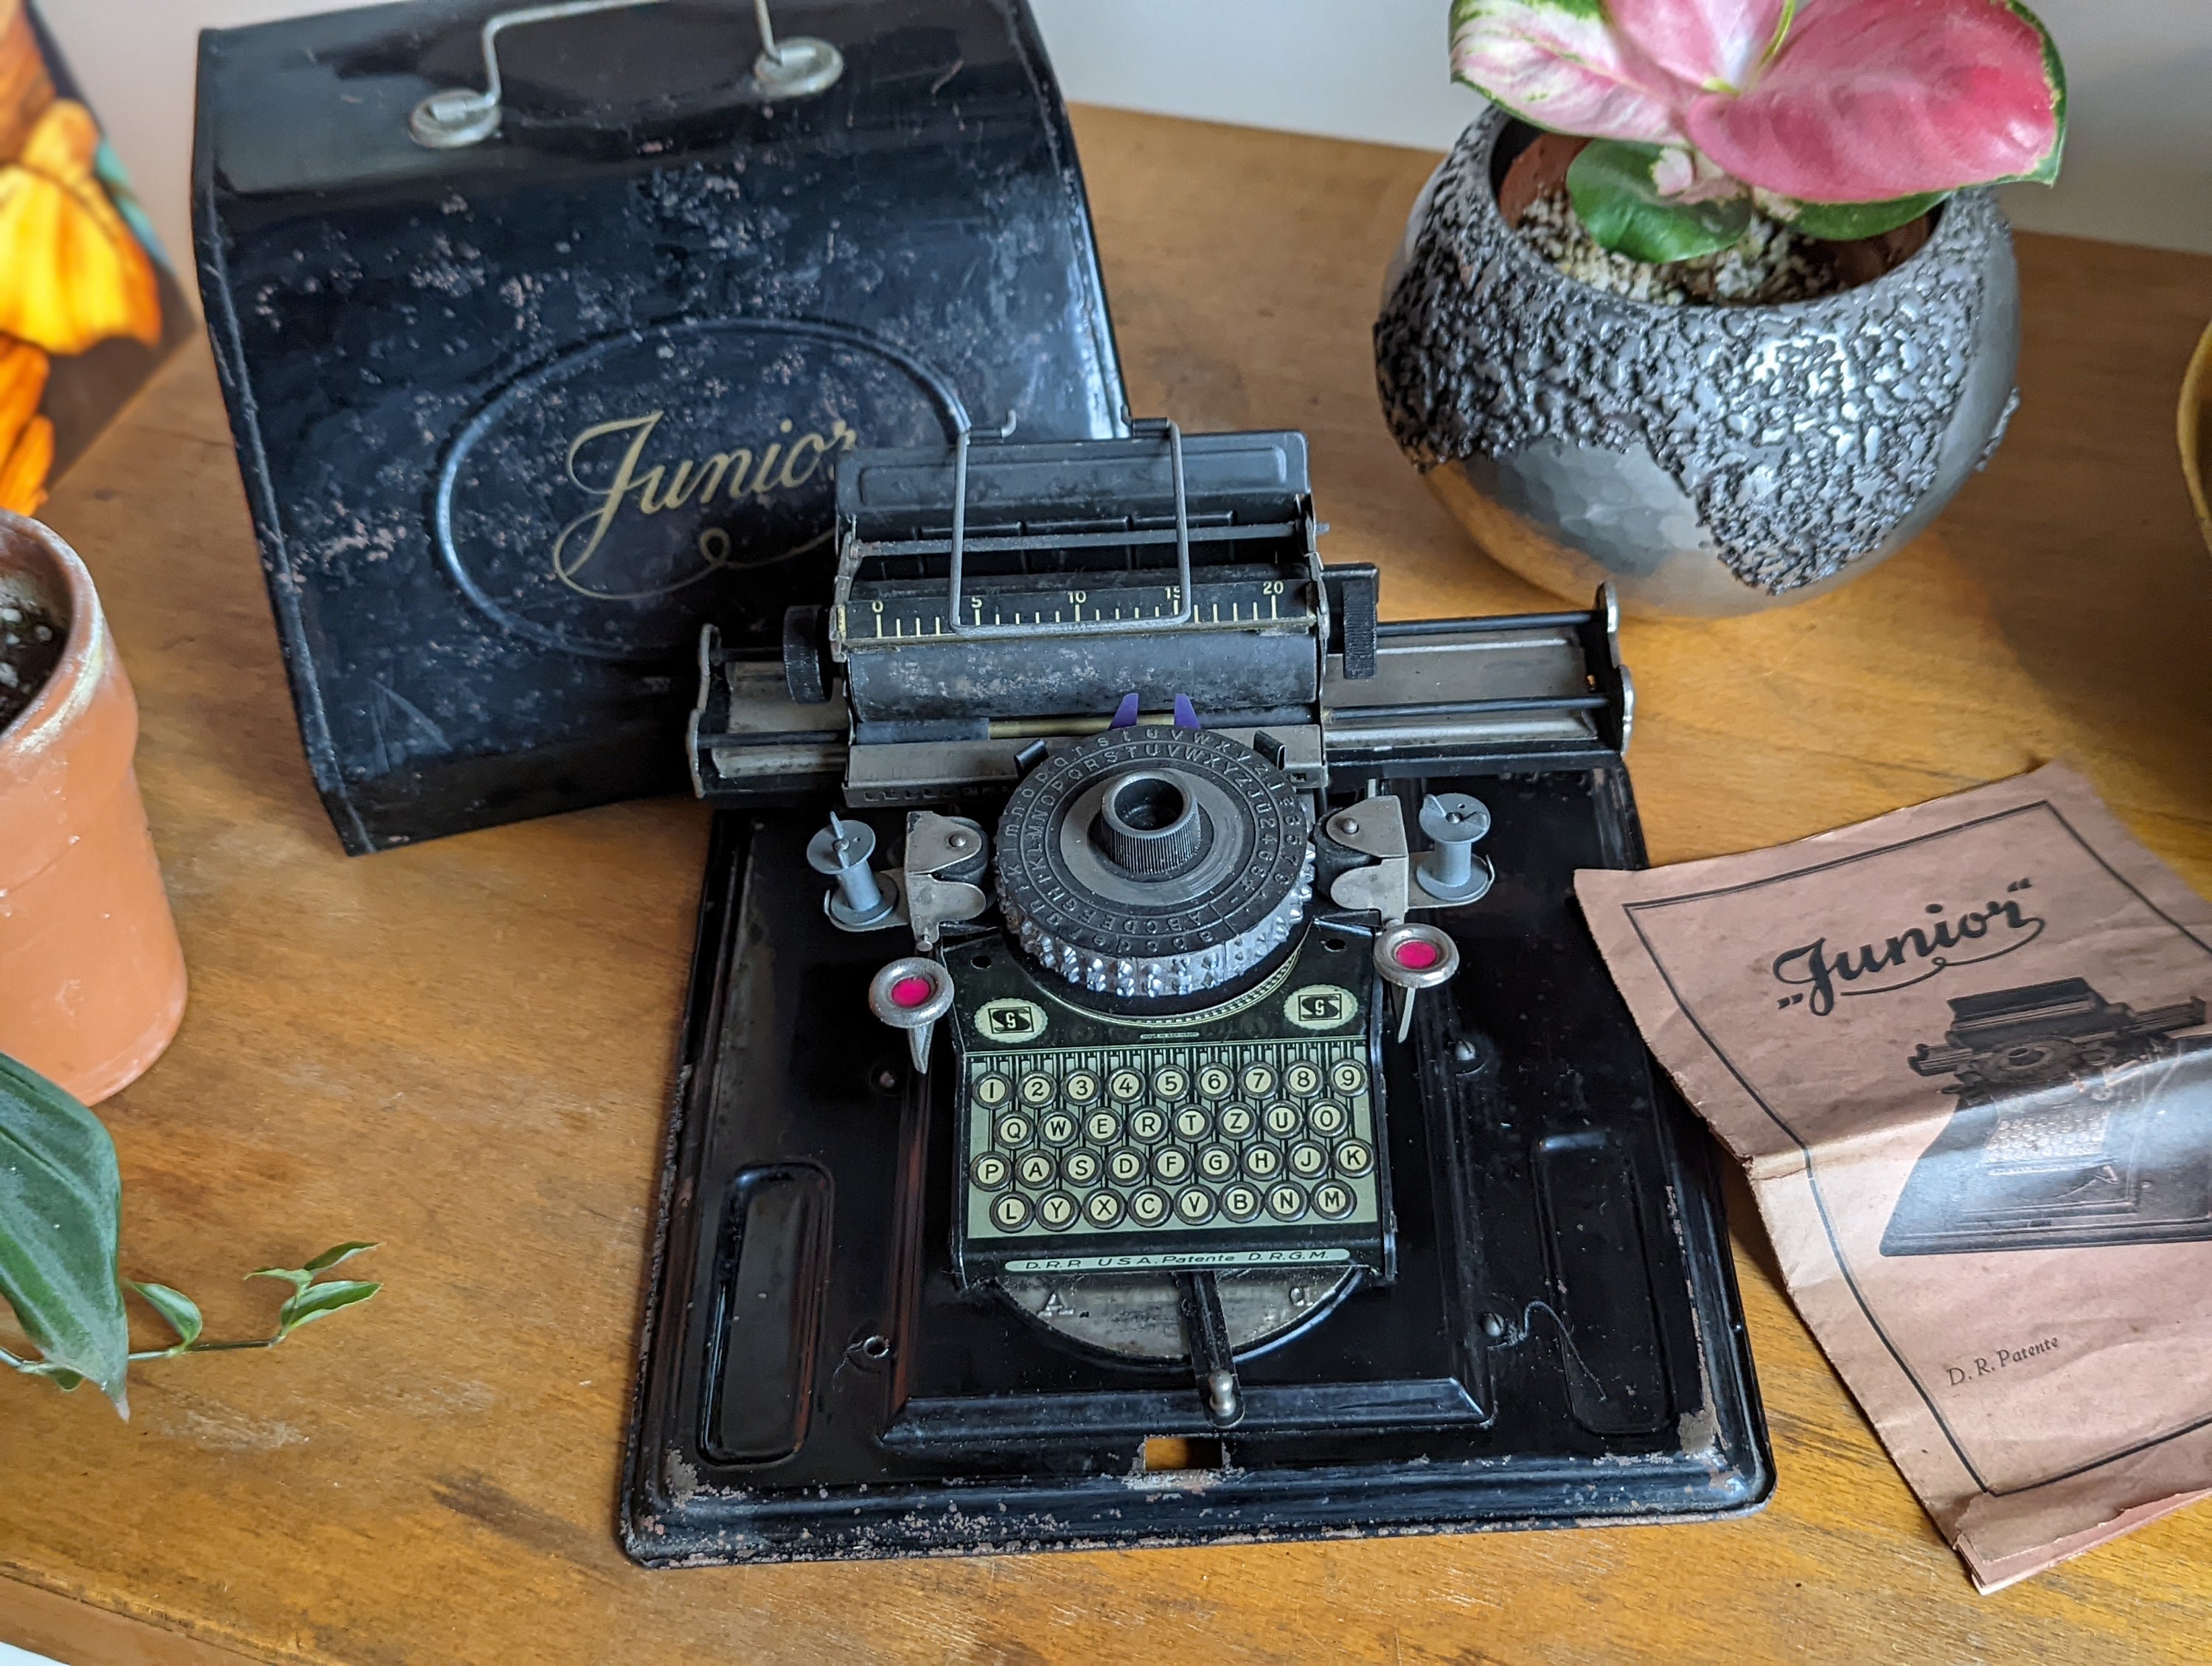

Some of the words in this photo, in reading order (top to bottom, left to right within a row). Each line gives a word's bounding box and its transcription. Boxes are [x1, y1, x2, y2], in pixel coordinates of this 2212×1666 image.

[872, 600, 884, 613] 0
[970, 596, 982, 608] 5
[1068, 591, 1087, 604] 10
[1164, 586, 1180, 599] 15
[1263, 580, 1284, 594] 20
[1031, 1081, 1044, 1097] 2
[1076, 1079, 1088, 1097] 3
[1119, 1077, 1133, 1094] 4
[1165, 1075, 1178, 1092] 5
[1208, 1073, 1221, 1090] 6
[1253, 1072, 1265, 1089] 7
[1297, 1070, 1311, 1088] 8
[1340, 1069, 1355, 1086] 9
[1006, 1122, 1021, 1139] Q
[1050, 1120, 1067, 1137] W
[1097, 1118, 1108, 1134] E
[1141, 1116, 1155, 1133] R
[1185, 1114, 1197, 1131] T
[1230, 1112, 1243, 1129] Z
[1276, 1111, 1288, 1129] U
[1319, 1110, 1334, 1128] O
[985, 1163, 999, 1180] P
[1028, 1162, 1043, 1178] A
[1075, 1159, 1088, 1176] S
[1119, 1158, 1133, 1174] D
[1166, 1156, 1177, 1172] F
[1208, 1154, 1222, 1171] G
[1255, 1153, 1268, 1169] H
[1300, 1150, 1312, 1167] J
[1346, 1149, 1361, 1166] K
[1006, 1203, 1018, 1221] L
[1050, 1201, 1064, 1219] Y
[1096, 1198, 1113, 1216] X
[1141, 1197, 1155, 1215] C
[1188, 1195, 1200, 1213] V
[1234, 1193, 1248, 1210] B
[1279, 1192, 1293, 1209] N
[1324, 1190, 1340, 1208] M
[1162, 1254, 1235, 1264] Patente
[1946, 1367, 1972, 1386] D.
[1973, 1357, 1996, 1376] R.
[1995, 1336, 2059, 1368] Patente
